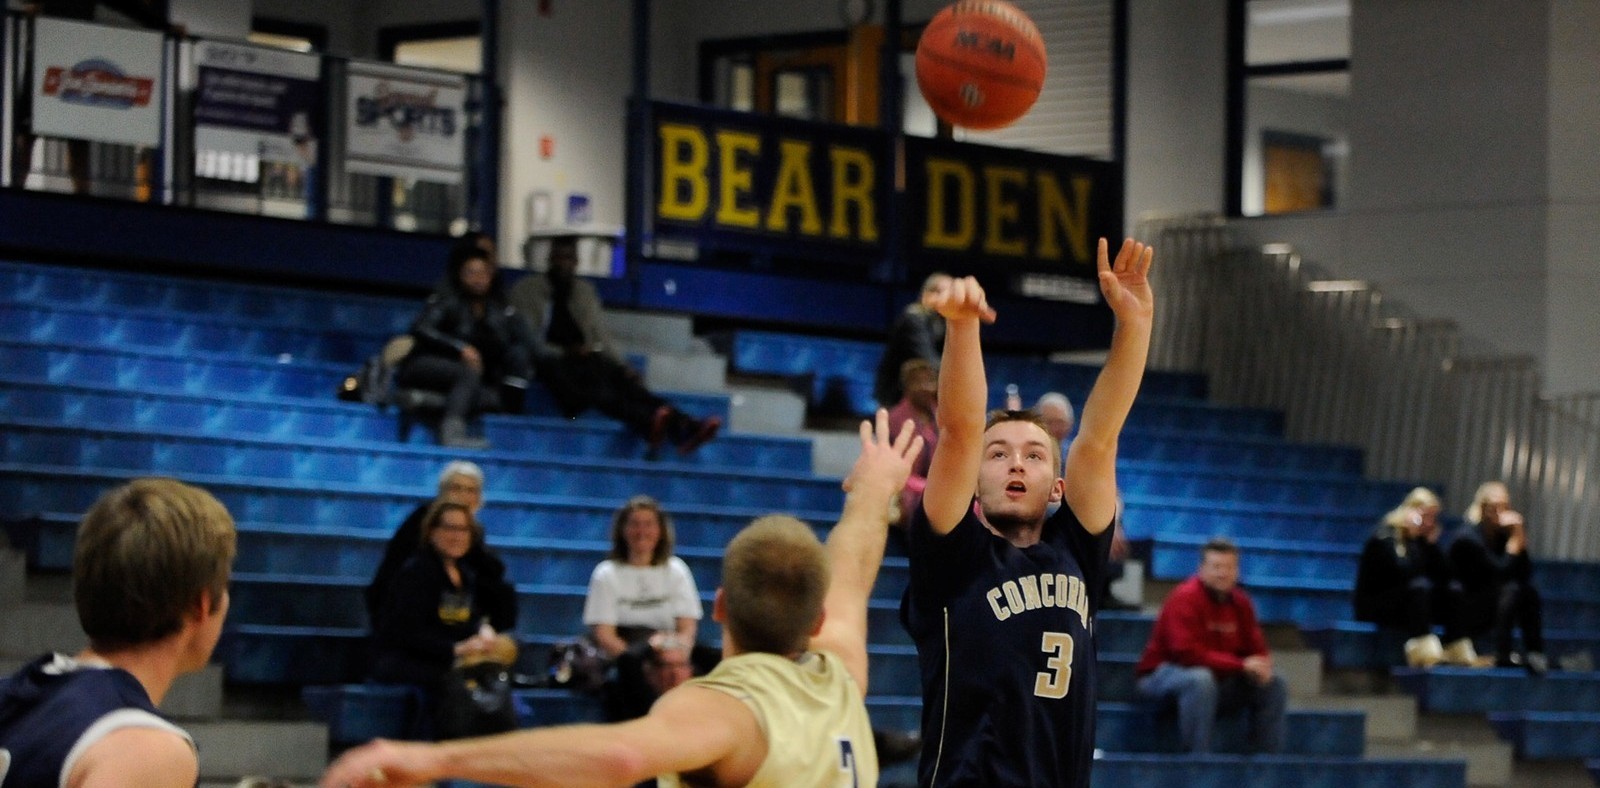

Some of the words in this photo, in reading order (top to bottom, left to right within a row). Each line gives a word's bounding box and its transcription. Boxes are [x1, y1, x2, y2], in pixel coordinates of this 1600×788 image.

[357, 97, 456, 139] SPORTS
[658, 123, 879, 242] BEAR
[923, 158, 1092, 264] DEN
[1033, 631, 1074, 700] 3
